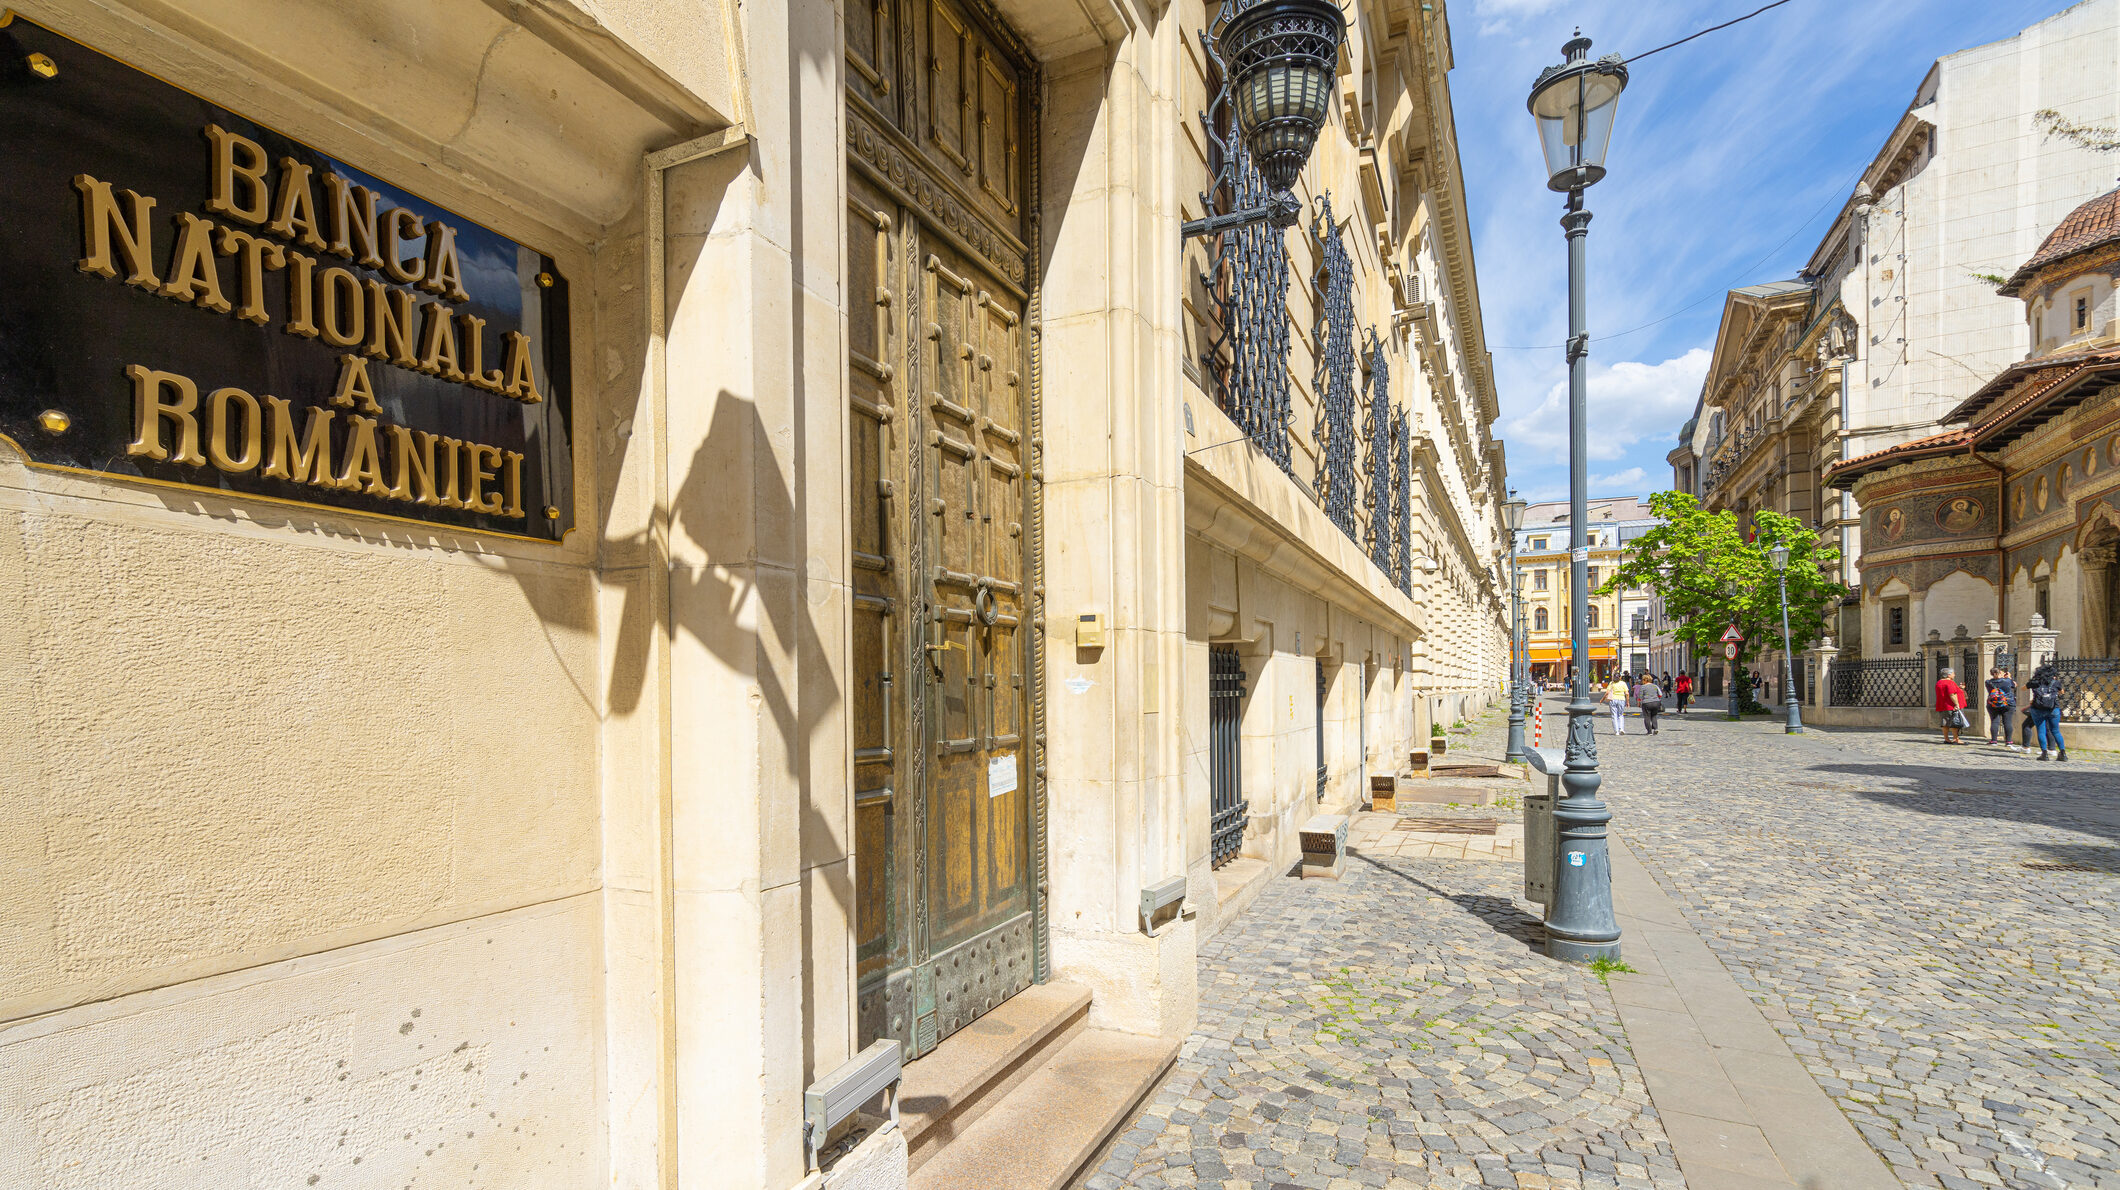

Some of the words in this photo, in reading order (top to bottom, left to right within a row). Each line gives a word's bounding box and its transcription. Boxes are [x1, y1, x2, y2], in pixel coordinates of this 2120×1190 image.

[74, 173, 543, 404] NATIONALA
[204, 123, 470, 302] BANCA
[126, 364, 525, 519] ROMANIEI
[329, 353, 383, 414] A
[1727, 646, 1735, 655] 30
